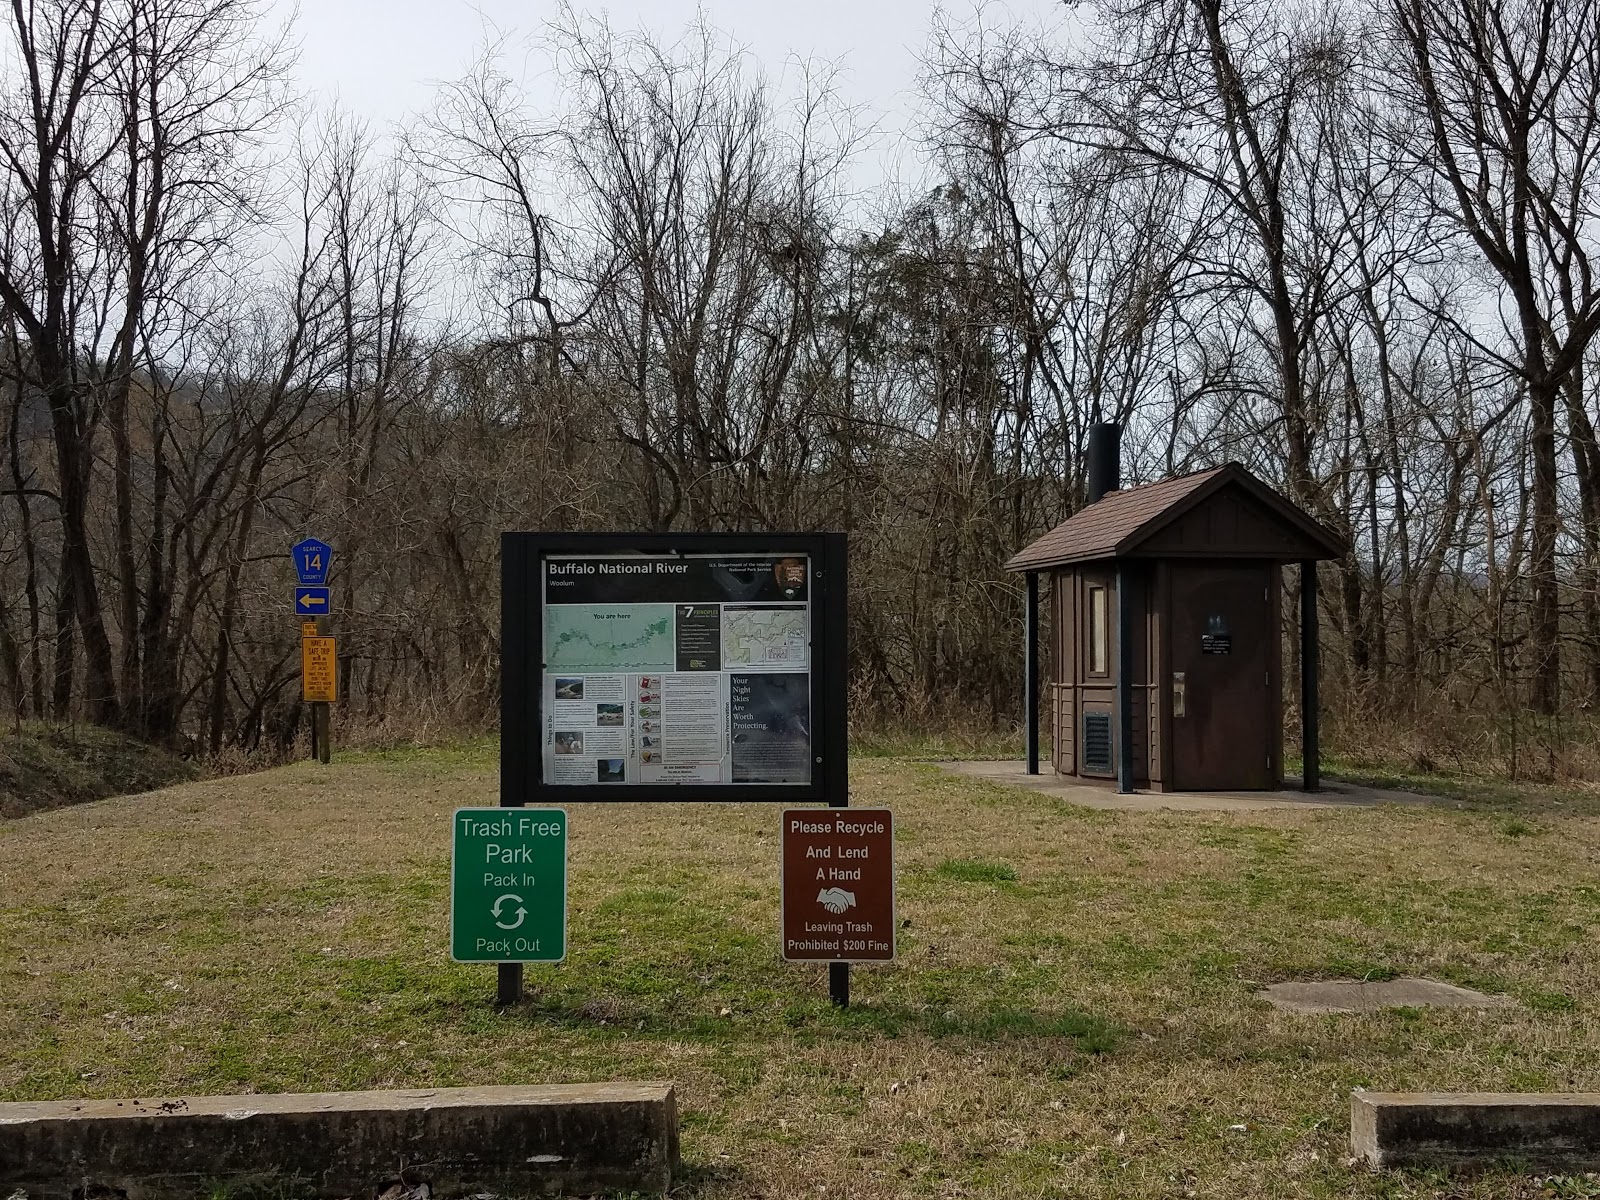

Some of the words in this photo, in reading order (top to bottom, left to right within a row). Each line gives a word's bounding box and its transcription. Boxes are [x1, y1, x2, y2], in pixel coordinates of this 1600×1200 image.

[304, 554, 322, 571] 14
[549, 563, 596, 574] Buffalo
[599, 562, 652, 574] National
[656, 562, 688, 574] River
[684, 606, 694, 618] 7
[733, 722, 768, 730] Protecting.
[460, 818, 512, 836] Trash
[519, 818, 561, 836] Free
[791, 820, 831, 833] Please
[836, 820, 884, 836] Recycle
[486, 844, 533, 863] Park
[806, 846, 830, 858] And
[838, 846, 868, 858] Lend
[484, 873, 518, 886] Pack
[523, 873, 535, 886] In
[816, 868, 825, 880] A
[830, 868, 860, 880] Hand
[805, 922, 843, 934] Leaving
[846, 922, 872, 932] Trash
[476, 938, 510, 952] Pack
[515, 938, 540, 951] Out
[788, 940, 839, 950] Prohibited
[844, 940, 866, 951] $200
[868, 941, 888, 950] Fine
